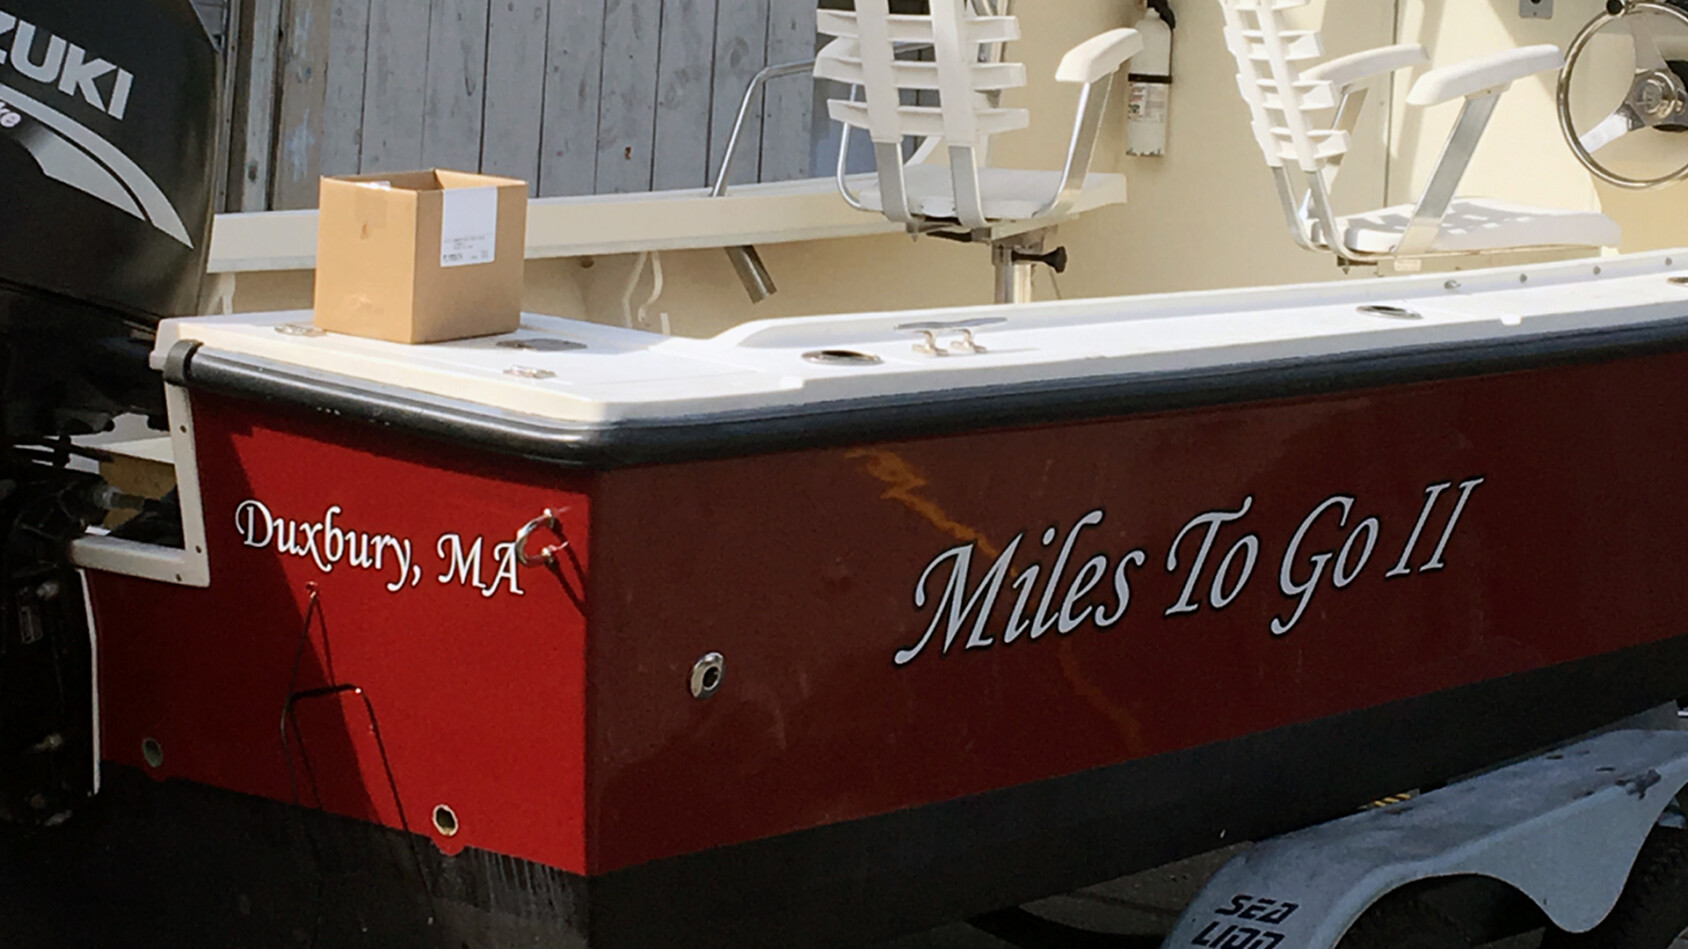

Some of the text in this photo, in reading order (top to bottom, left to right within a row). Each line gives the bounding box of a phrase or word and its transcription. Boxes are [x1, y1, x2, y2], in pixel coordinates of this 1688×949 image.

[234, 499, 525, 597] Duxbury, MA
[894, 478, 1484, 664] Miles To Go II
[1214, 894, 1299, 925] SEA
